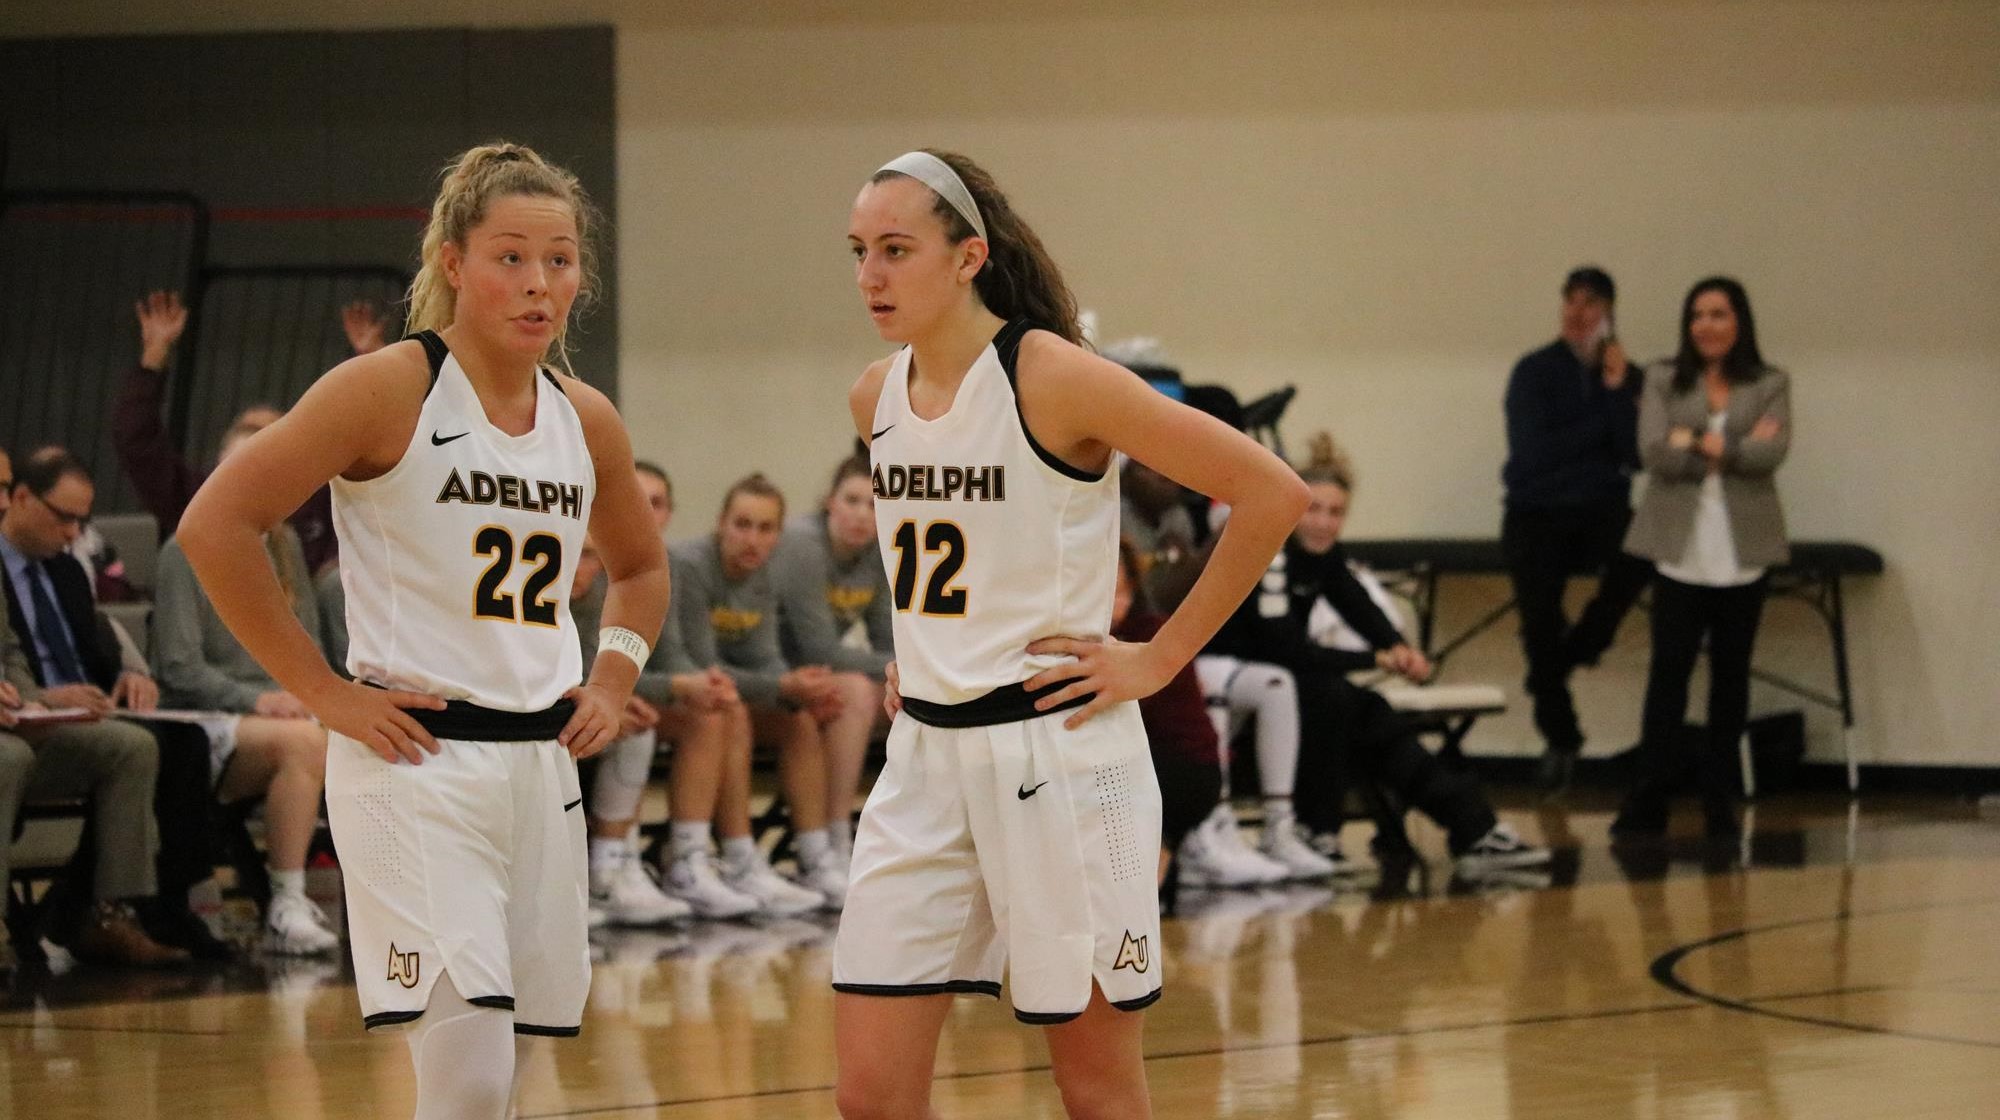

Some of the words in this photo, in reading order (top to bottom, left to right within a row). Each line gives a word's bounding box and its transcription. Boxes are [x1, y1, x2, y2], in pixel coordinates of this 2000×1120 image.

[872, 463, 1006, 501] ADELPHI
[472, 523, 560, 629] 22
[891, 518, 969, 618] 12
[387, 941, 419, 989] AU
[1112, 929, 1149, 973] AU
